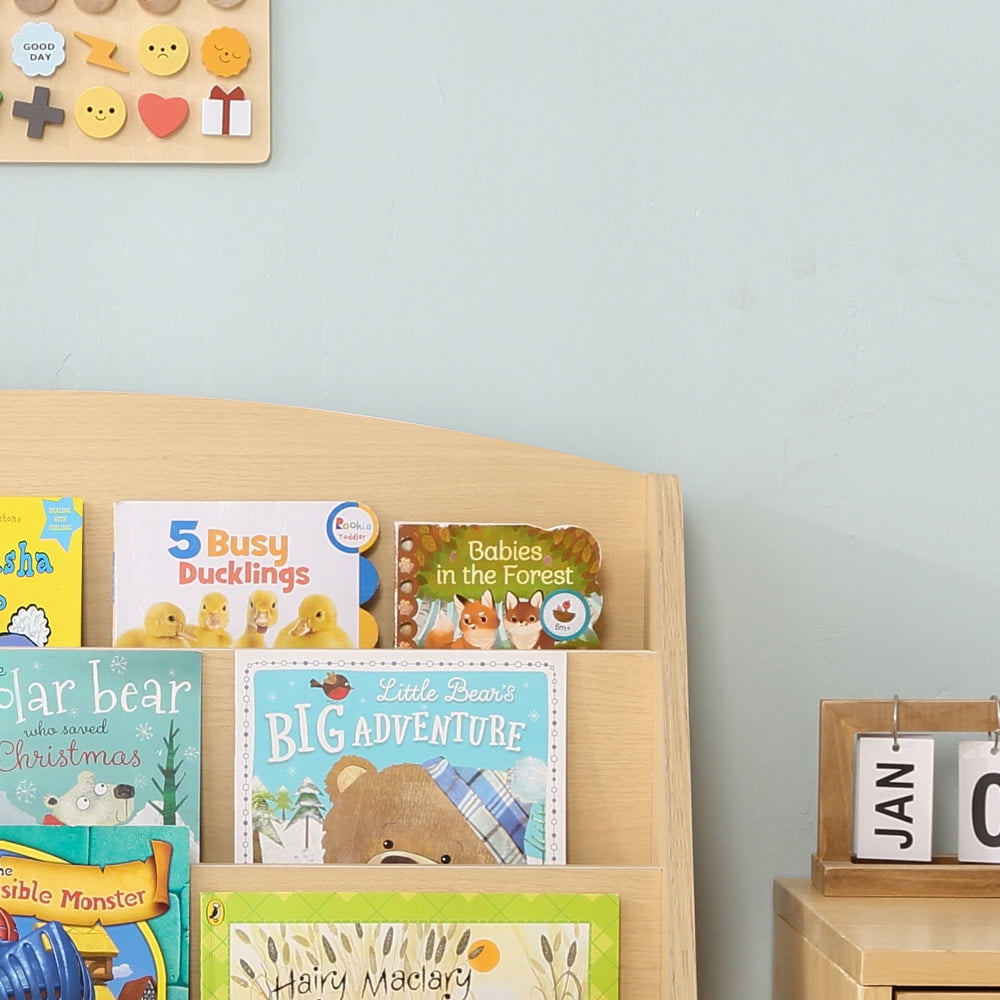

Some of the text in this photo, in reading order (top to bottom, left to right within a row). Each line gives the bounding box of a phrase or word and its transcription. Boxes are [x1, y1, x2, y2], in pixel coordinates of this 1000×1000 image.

[23, 42, 55, 51] GOOD
[30, 53, 52, 61] DAY
[336, 517, 372, 530] Rookie
[168, 519, 289, 567] 5 Busy
[468, 539, 543, 562] Babies
[179, 561, 310, 593] Ducklings
[436, 564, 574, 585] in the Forest
[88, 659, 192, 715] bear
[376, 676, 516, 704] Little Bear's
[24, 718, 110, 738] who saved
[265, 702, 527, 764] BIG ADVENTURE
[874, 762, 915, 850] JAN
[60, 888, 147, 911] Monster
